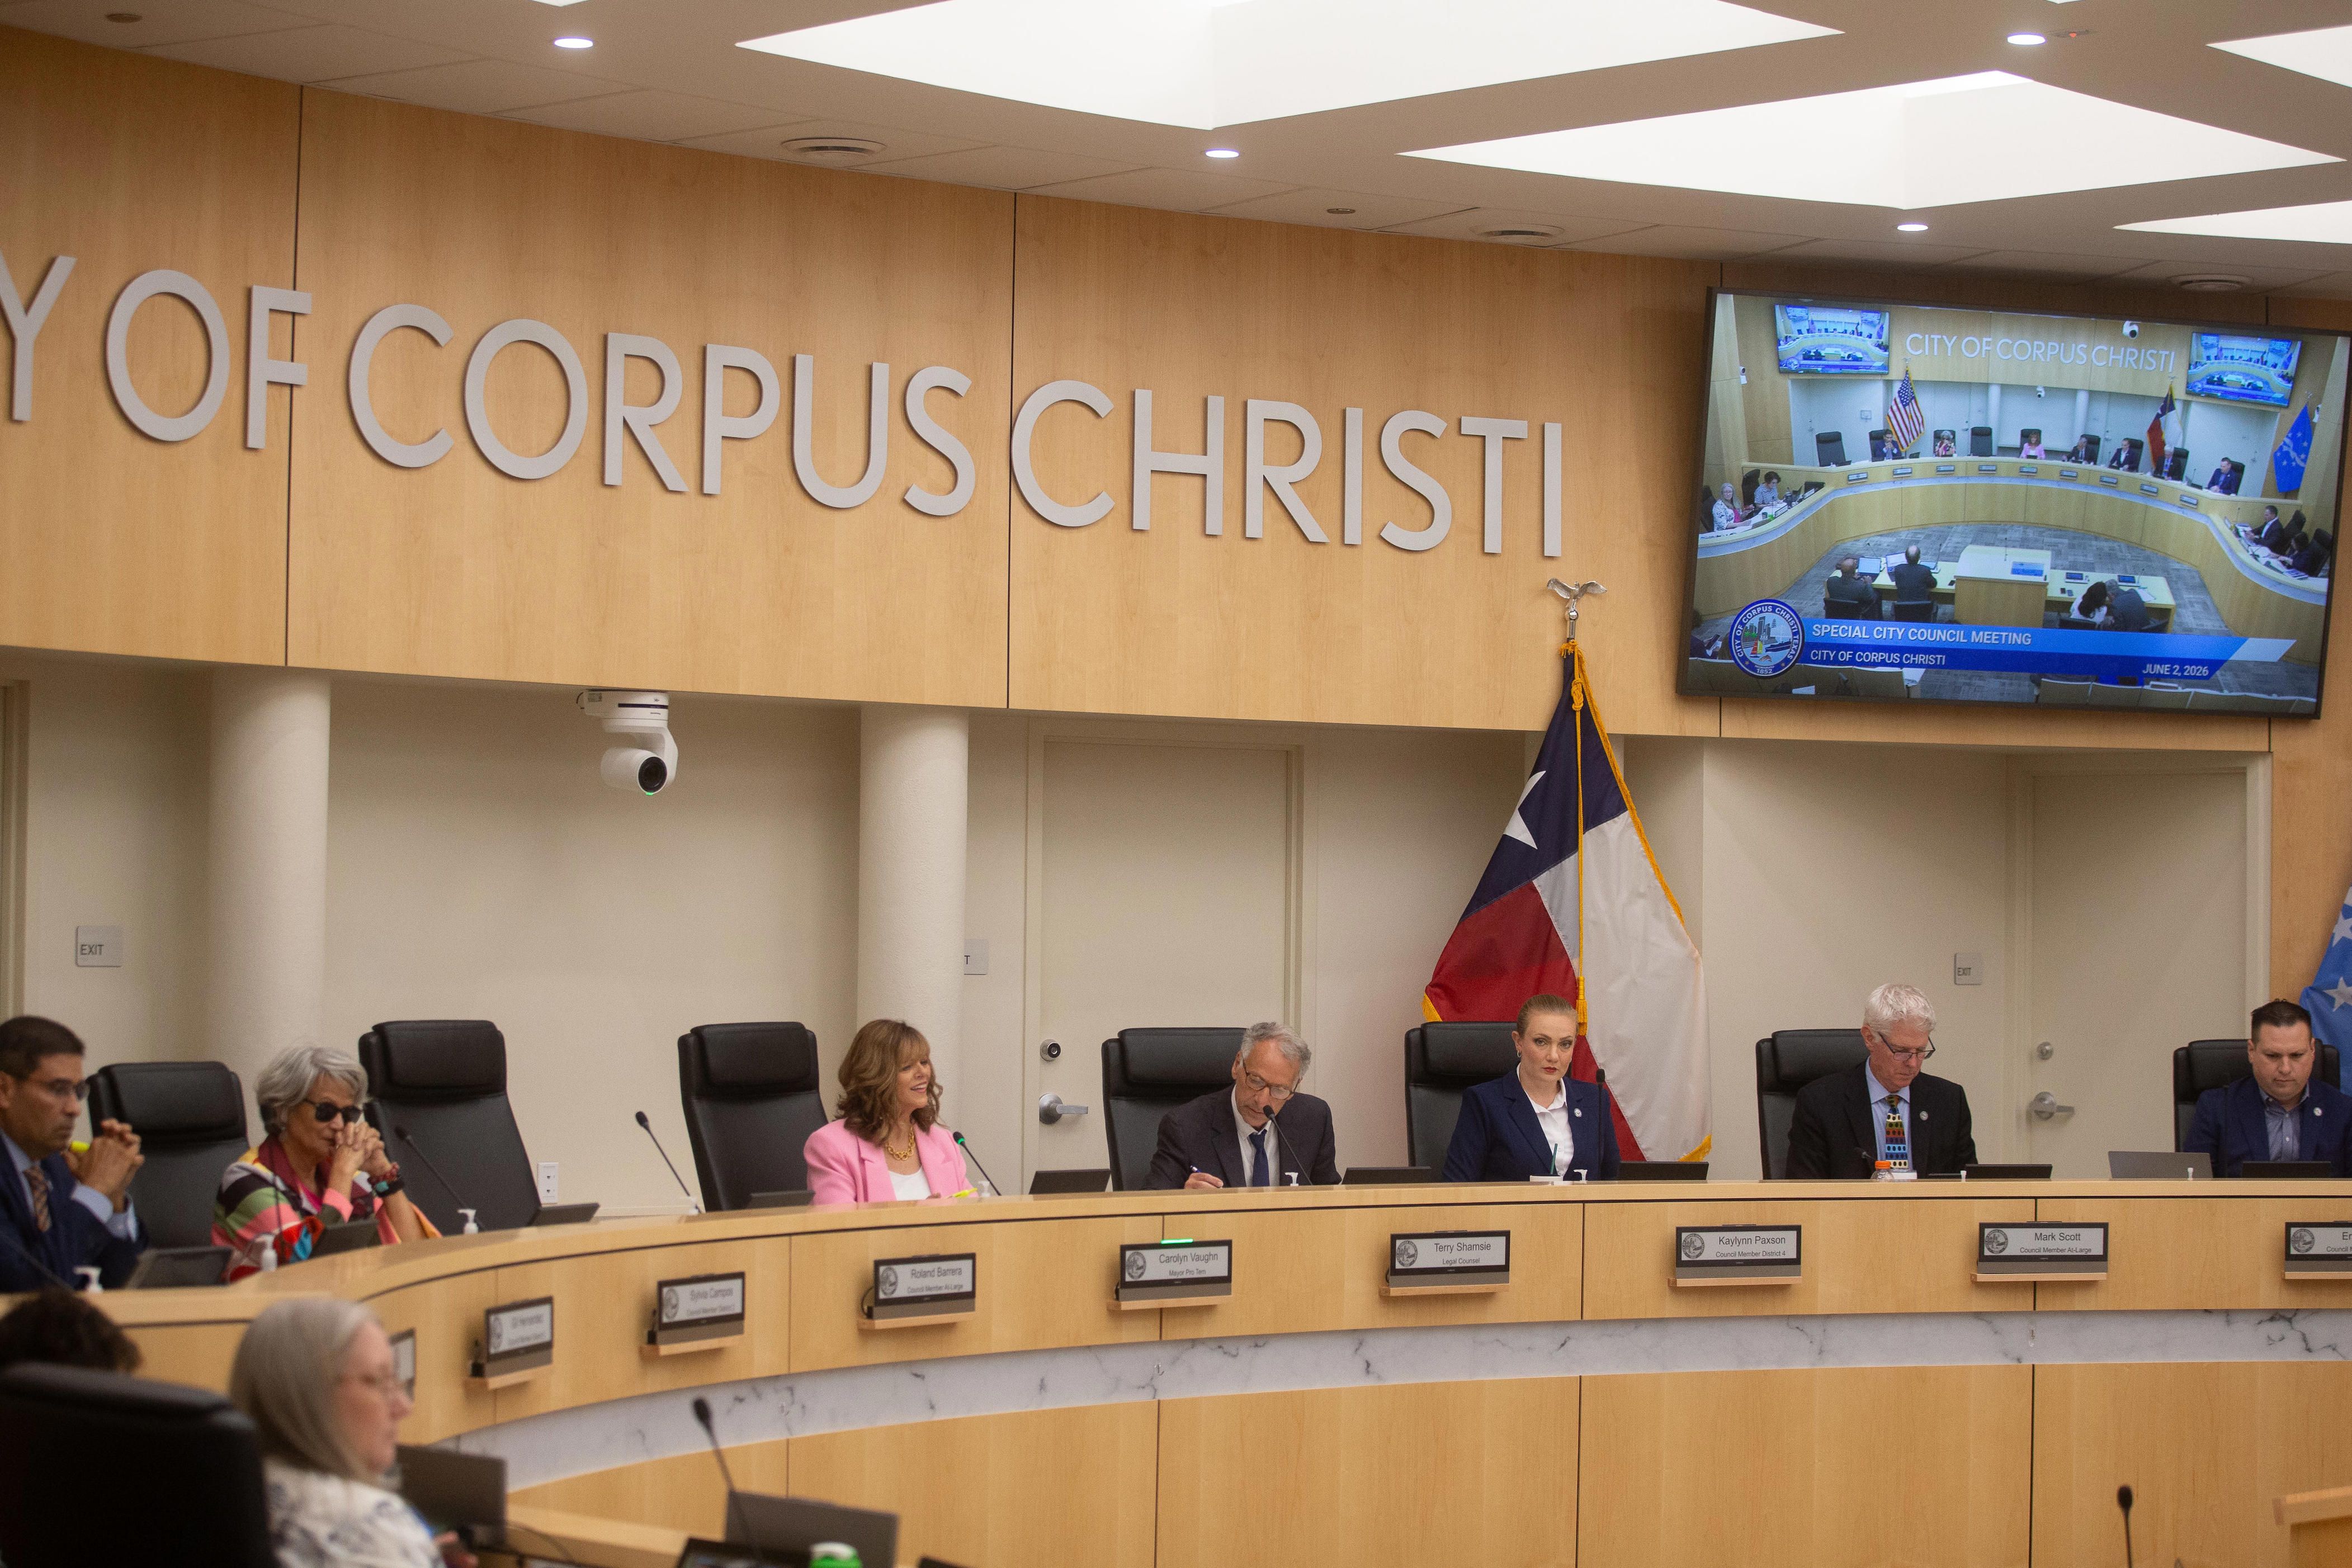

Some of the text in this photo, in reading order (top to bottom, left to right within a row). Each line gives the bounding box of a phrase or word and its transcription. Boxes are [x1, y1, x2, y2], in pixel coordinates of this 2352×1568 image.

[1905, 333, 2175, 372] CITY OF CORPUS CHRISTI
[107, 270, 312, 448] OF
[348, 304, 975, 516] CORPUS
[1011, 380, 1562, 557] CHRISTI
[1735, 606, 1800, 660] CITY OF CORPUS CHRISTI TEXAS
[1812, 624, 2032, 645] SPECIAL CITY COUNCIL MEETING
[1811, 650, 1946, 665] CITY OF CORPUS CHRISTI
[2142, 663, 2209, 677] JUNE 2, 2026
[80, 944, 105, 955] EXIT
[1719, 1236, 1786, 1247] Kaylynn Paxson
[2034, 1232, 2081, 1241] Mark Scott
[1434, 1241, 1491, 1254] Terry Shamsie
[1159, 1252, 1218, 1265] Carolyn Vaughn
[911, 1267, 962, 1279] Roland Barrera
[1169, 1269, 1184, 1278] Mayor
